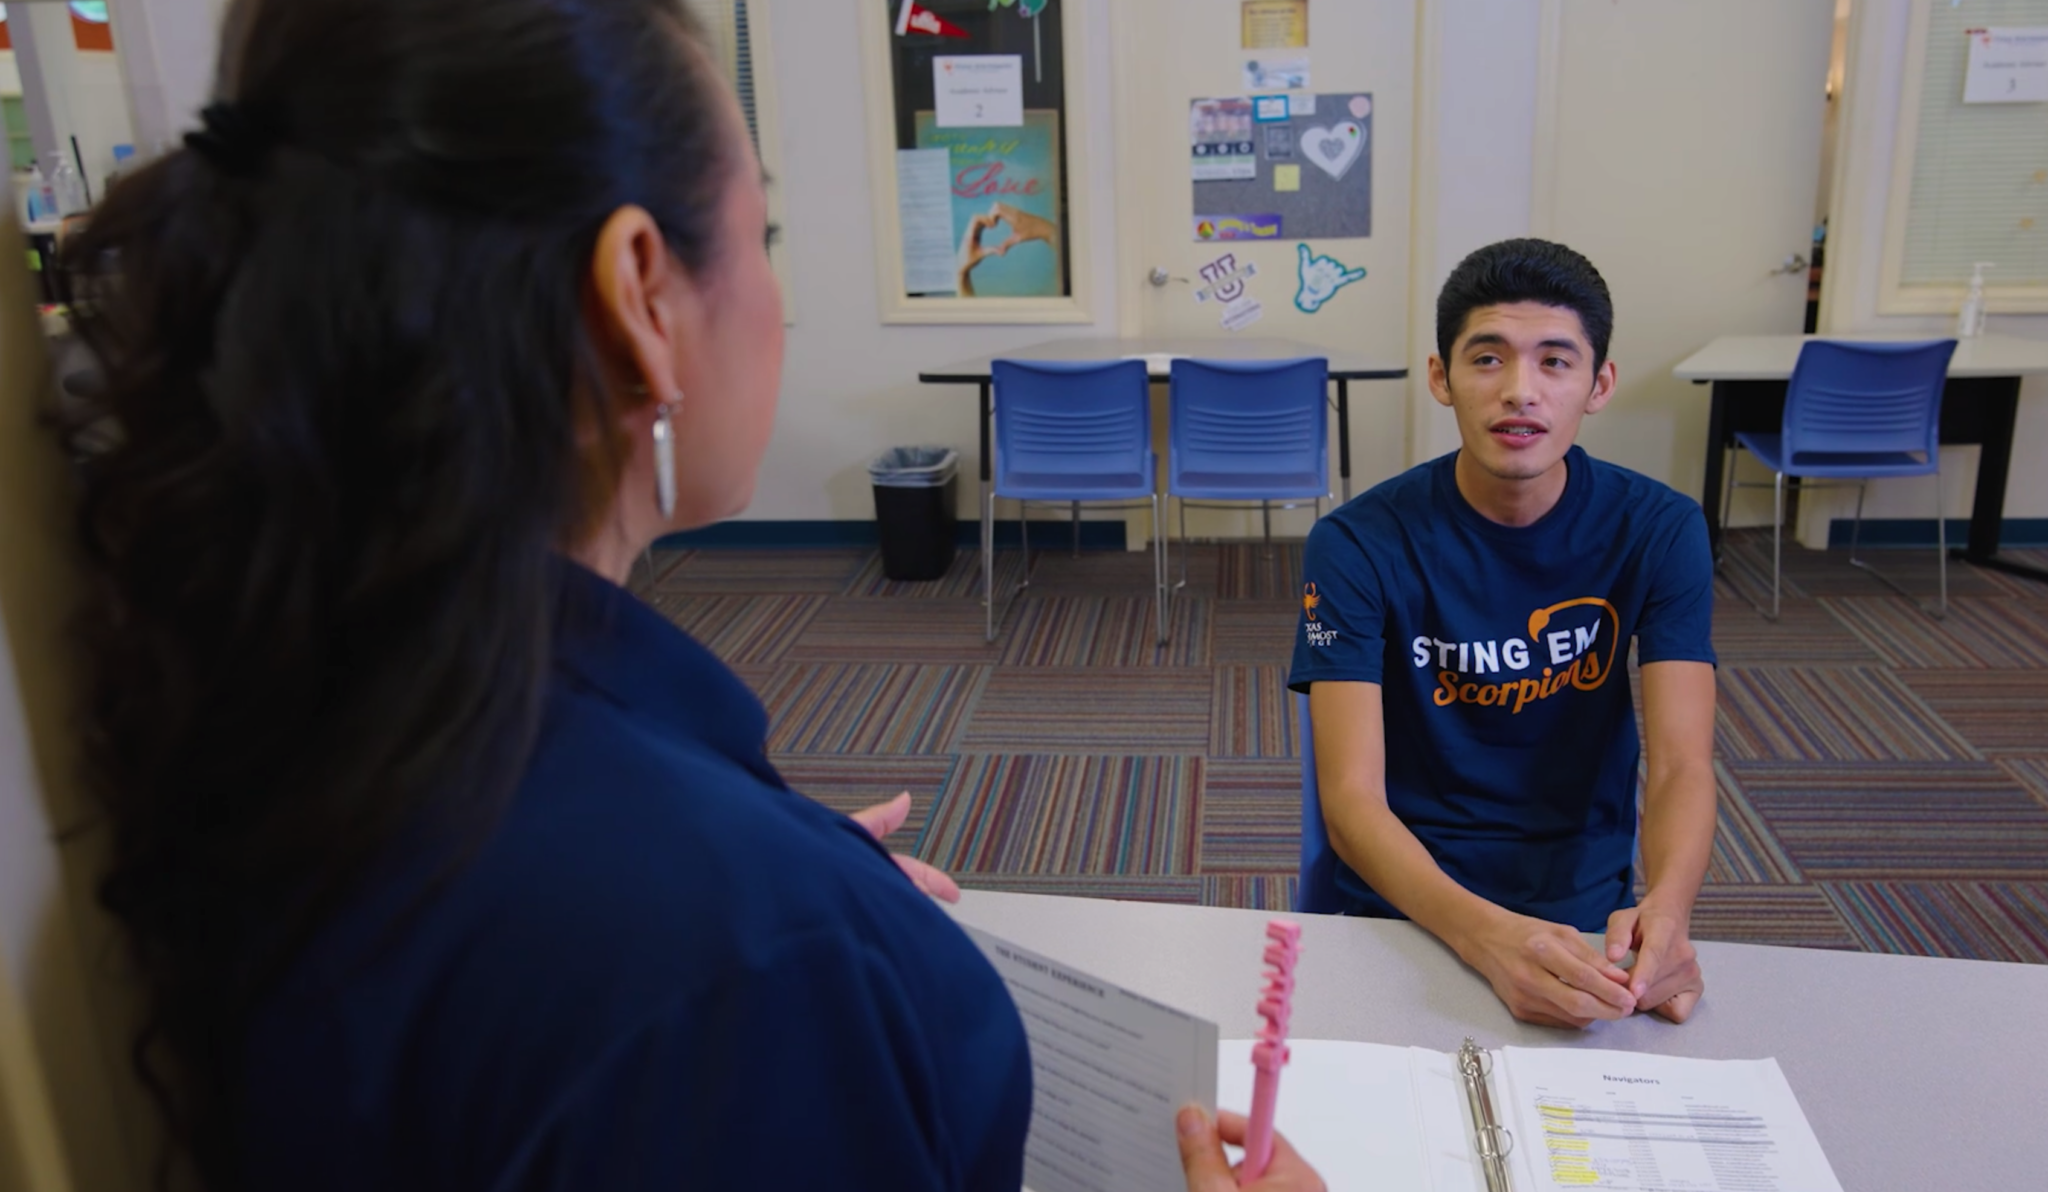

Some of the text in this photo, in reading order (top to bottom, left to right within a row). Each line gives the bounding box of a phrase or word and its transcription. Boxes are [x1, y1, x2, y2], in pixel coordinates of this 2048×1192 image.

[975, 104, 984, 118] 2
[950, 161, 1045, 198] Love
[1305, 621, 1322, 632] XAS
[1412, 635, 1530, 674] STING
[1433, 651, 1602, 715] Scorpions
[1051, 968, 1106, 998] EXPERIENCE
[1602, 1074, 1661, 1086] Navigators
